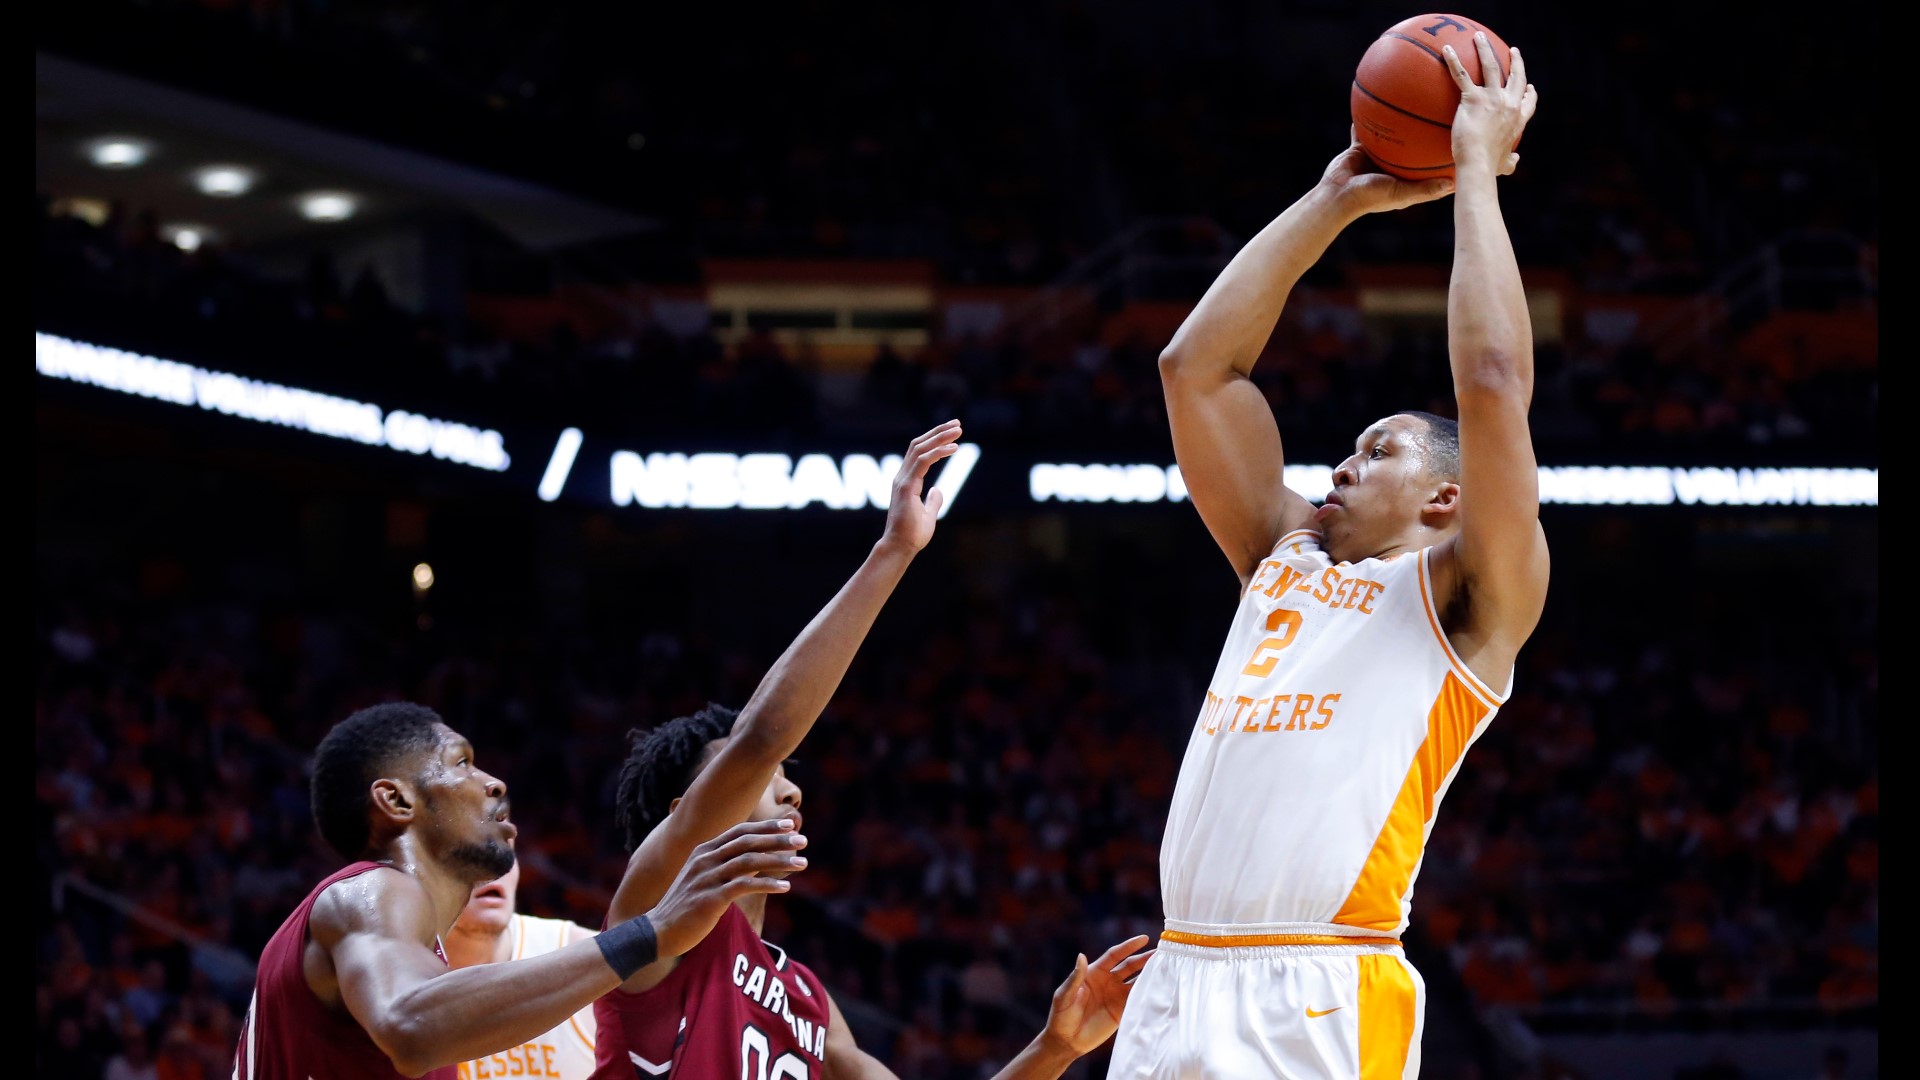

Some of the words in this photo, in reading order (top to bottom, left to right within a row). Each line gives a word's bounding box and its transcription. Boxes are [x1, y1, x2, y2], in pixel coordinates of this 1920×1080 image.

[1422, 15, 1468, 37] T
[610, 450, 906, 510] NISSAN
[1029, 463, 1167, 502] PROUD
[1241, 608, 1304, 679] 2
